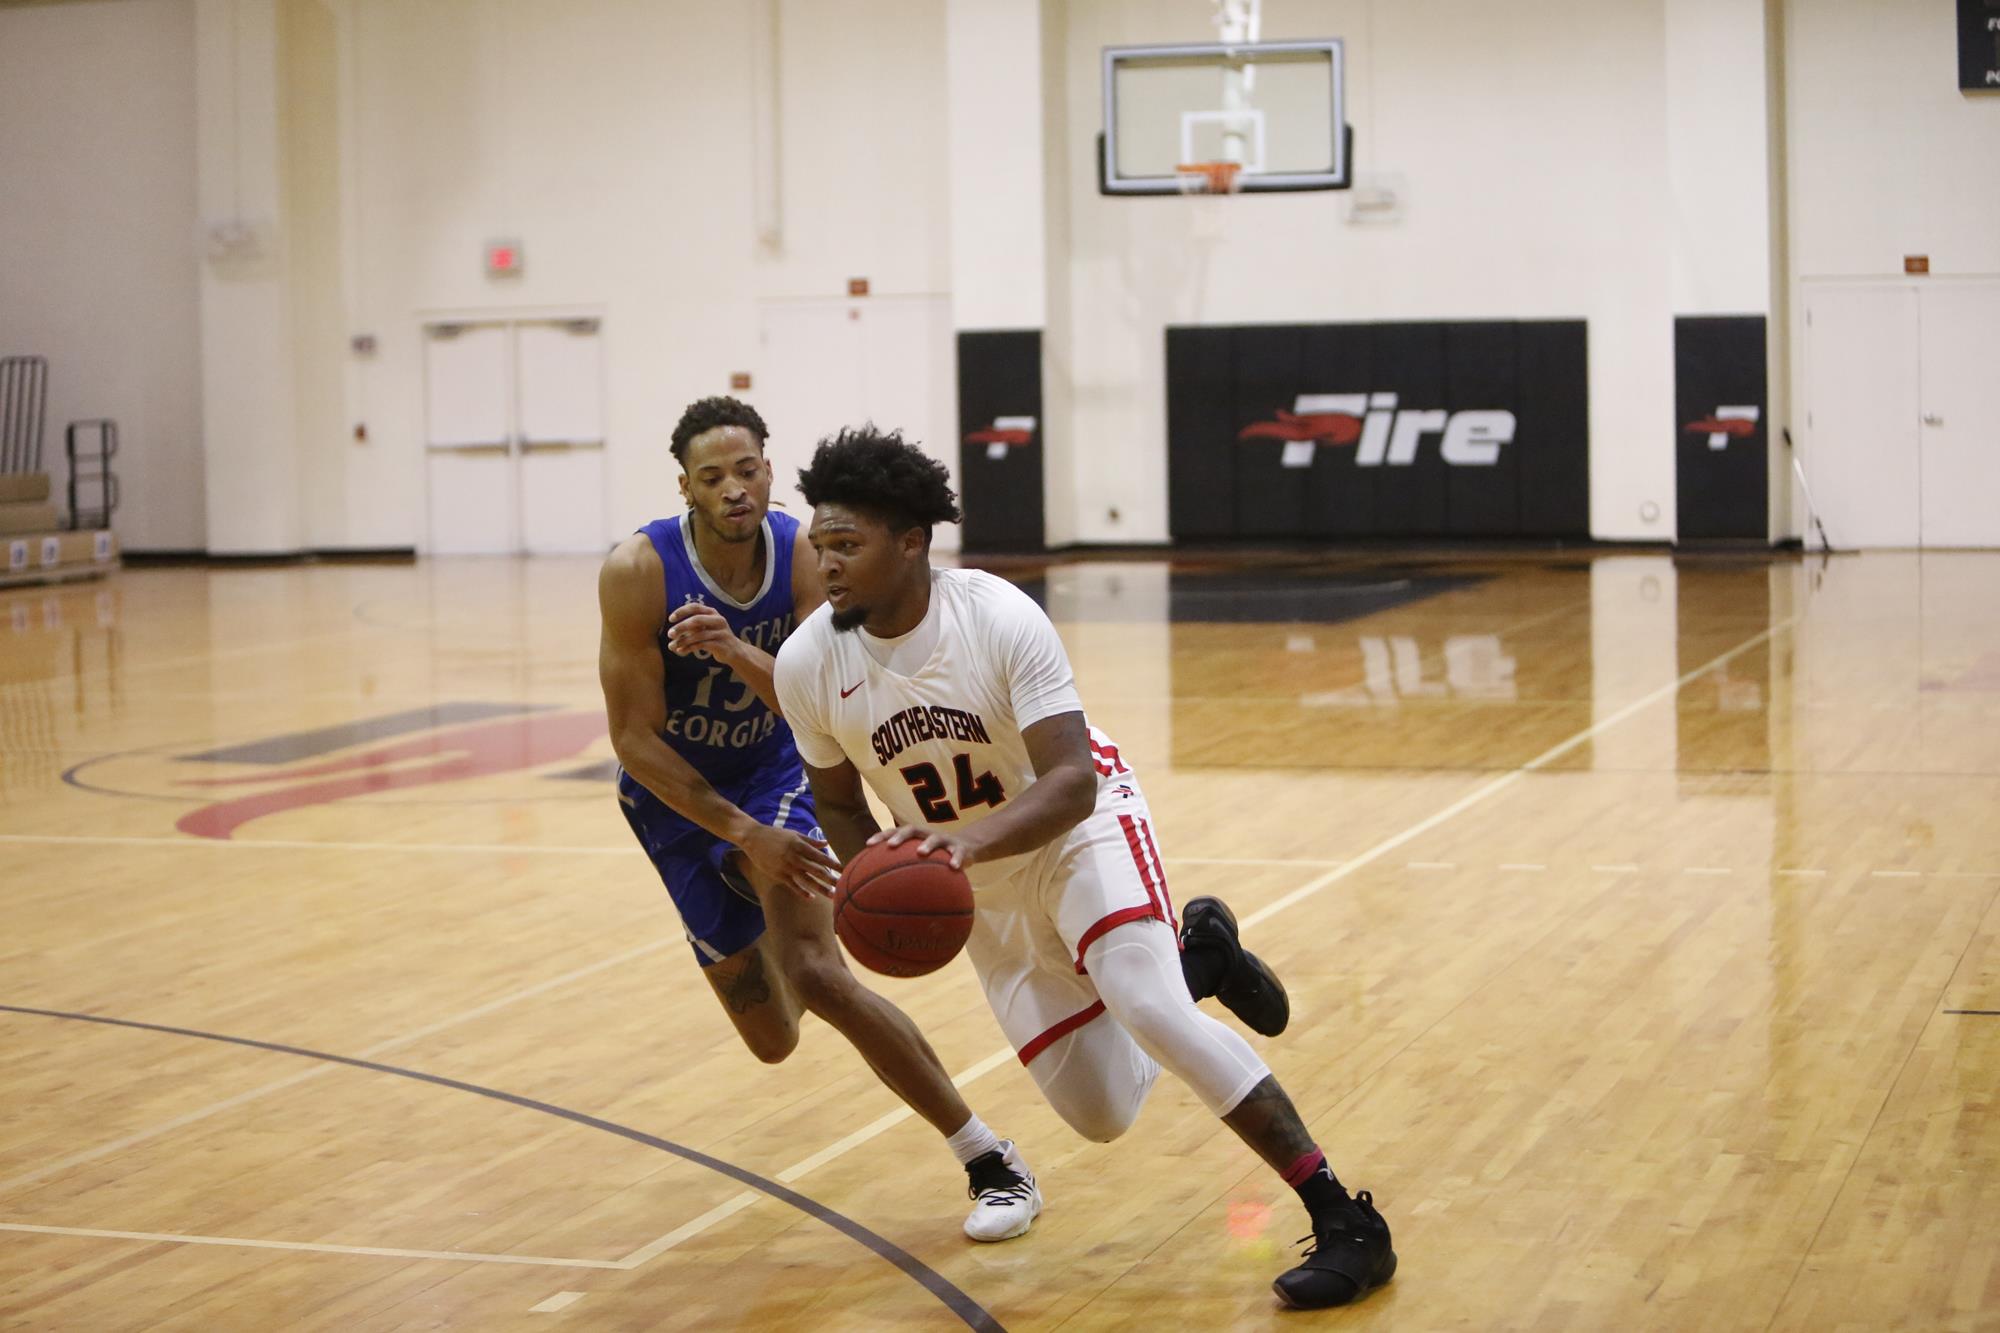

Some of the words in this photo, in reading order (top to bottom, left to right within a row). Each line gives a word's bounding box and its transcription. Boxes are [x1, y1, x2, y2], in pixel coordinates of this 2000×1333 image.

[1280, 392, 1517, 467] Fire
[665, 708, 776, 749] EORGIA
[871, 705, 992, 767] SOUTHEASTERN
[899, 752, 1007, 823] 24
